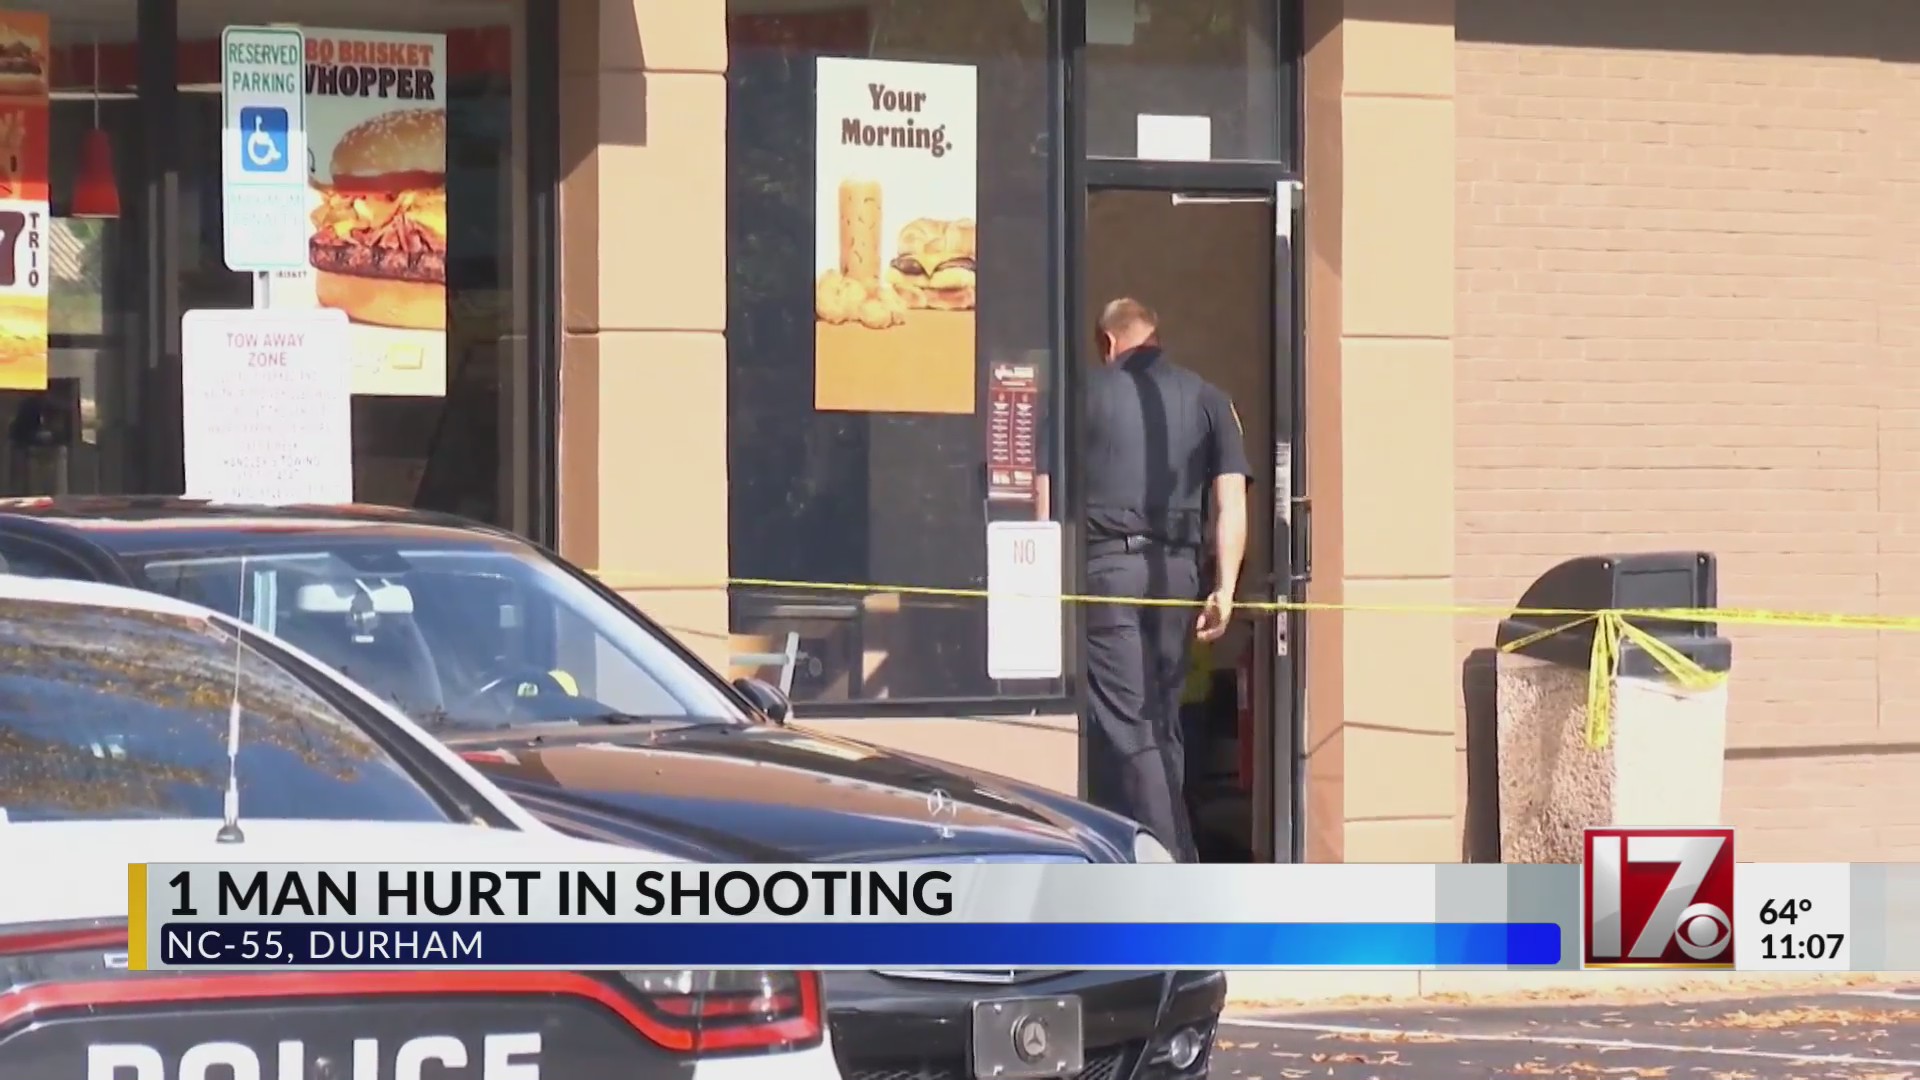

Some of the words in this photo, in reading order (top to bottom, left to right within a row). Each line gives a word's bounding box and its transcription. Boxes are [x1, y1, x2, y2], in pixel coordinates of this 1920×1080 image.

[229, 43, 298, 65] RESERVED
[339, 40, 433, 66] BRISKET
[232, 71, 295, 93] PARKING
[868, 83, 927, 112] Your
[841, 118, 952, 158] Morning.
[28, 212, 41, 288] TRIO
[226, 333, 258, 347] TOW
[263, 333, 305, 347] AWAY
[248, 352, 288, 367] ZONE
[1013, 539, 1036, 565] NO
